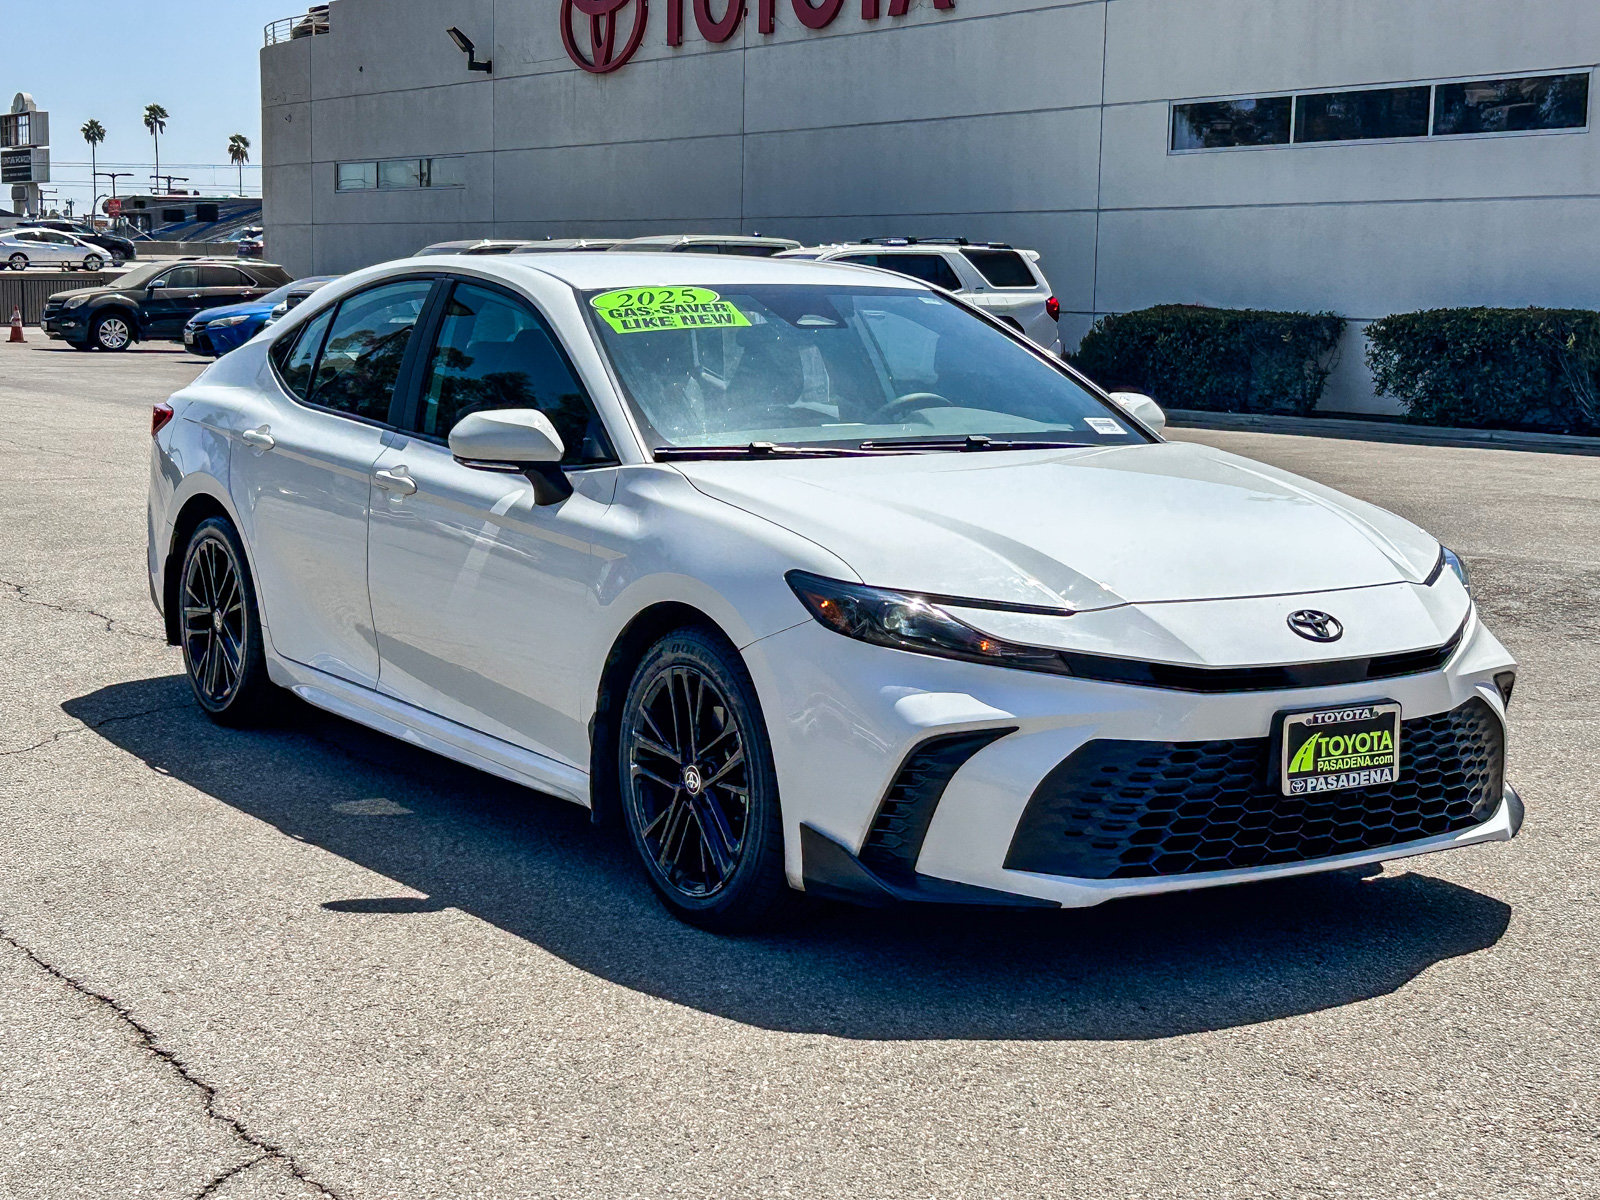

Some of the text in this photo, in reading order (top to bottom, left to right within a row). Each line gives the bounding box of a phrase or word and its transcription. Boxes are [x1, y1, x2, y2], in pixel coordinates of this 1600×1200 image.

[617, 289, 697, 308] 2025
[608, 303, 730, 319] GAS-SAVER
[621, 313, 734, 330] LIKE NEW
[1315, 708, 1371, 724] TOYOTA
[1318, 730, 1393, 757] TOYOTA
[1317, 754, 1393, 772] PASADENA.com
[1306, 768, 1392, 792] PASADENA
